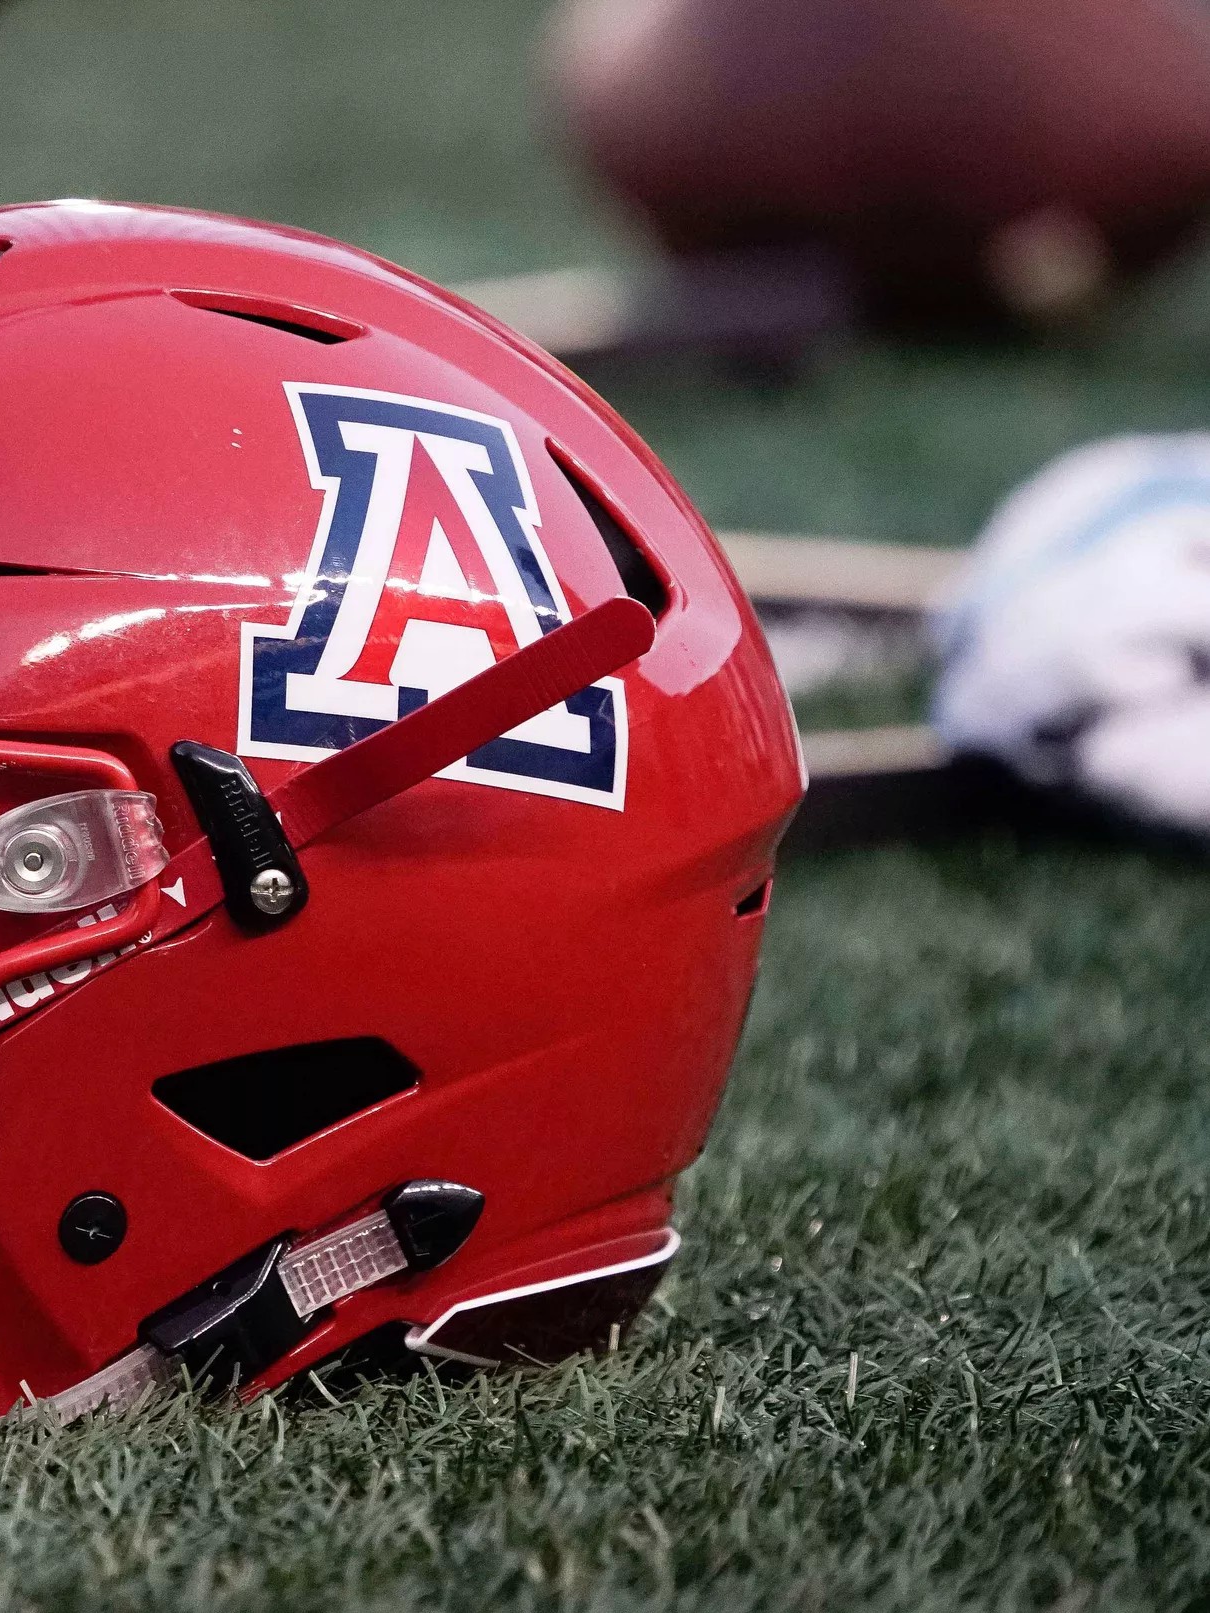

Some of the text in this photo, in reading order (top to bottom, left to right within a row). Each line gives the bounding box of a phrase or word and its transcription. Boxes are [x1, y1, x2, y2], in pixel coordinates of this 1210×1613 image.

[236, 381, 629, 813] A
[111, 800, 146, 880] Riddell
[220, 780, 273, 868] Riddell
